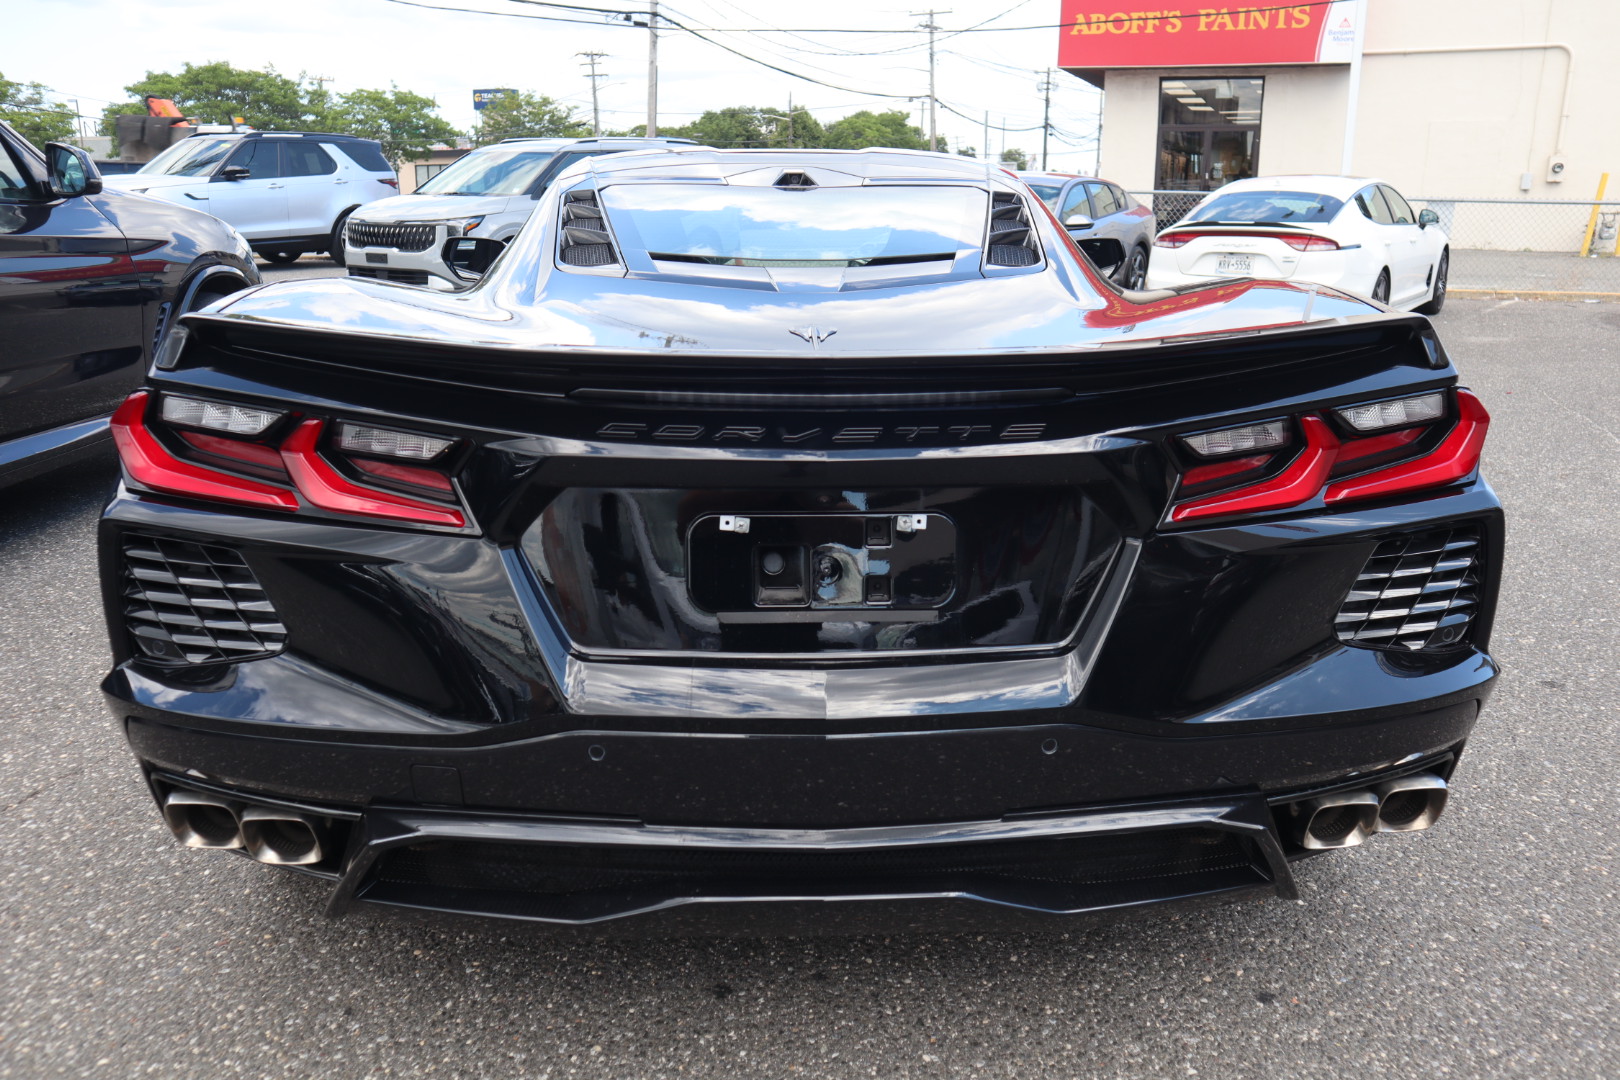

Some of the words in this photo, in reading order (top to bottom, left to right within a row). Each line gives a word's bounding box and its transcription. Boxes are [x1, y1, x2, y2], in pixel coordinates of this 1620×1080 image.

[1070, 10, 1182, 35] ABOFF'S
[1197, 6, 1311, 31] PAINTS
[597, 422, 1048, 442] CORVETTE
